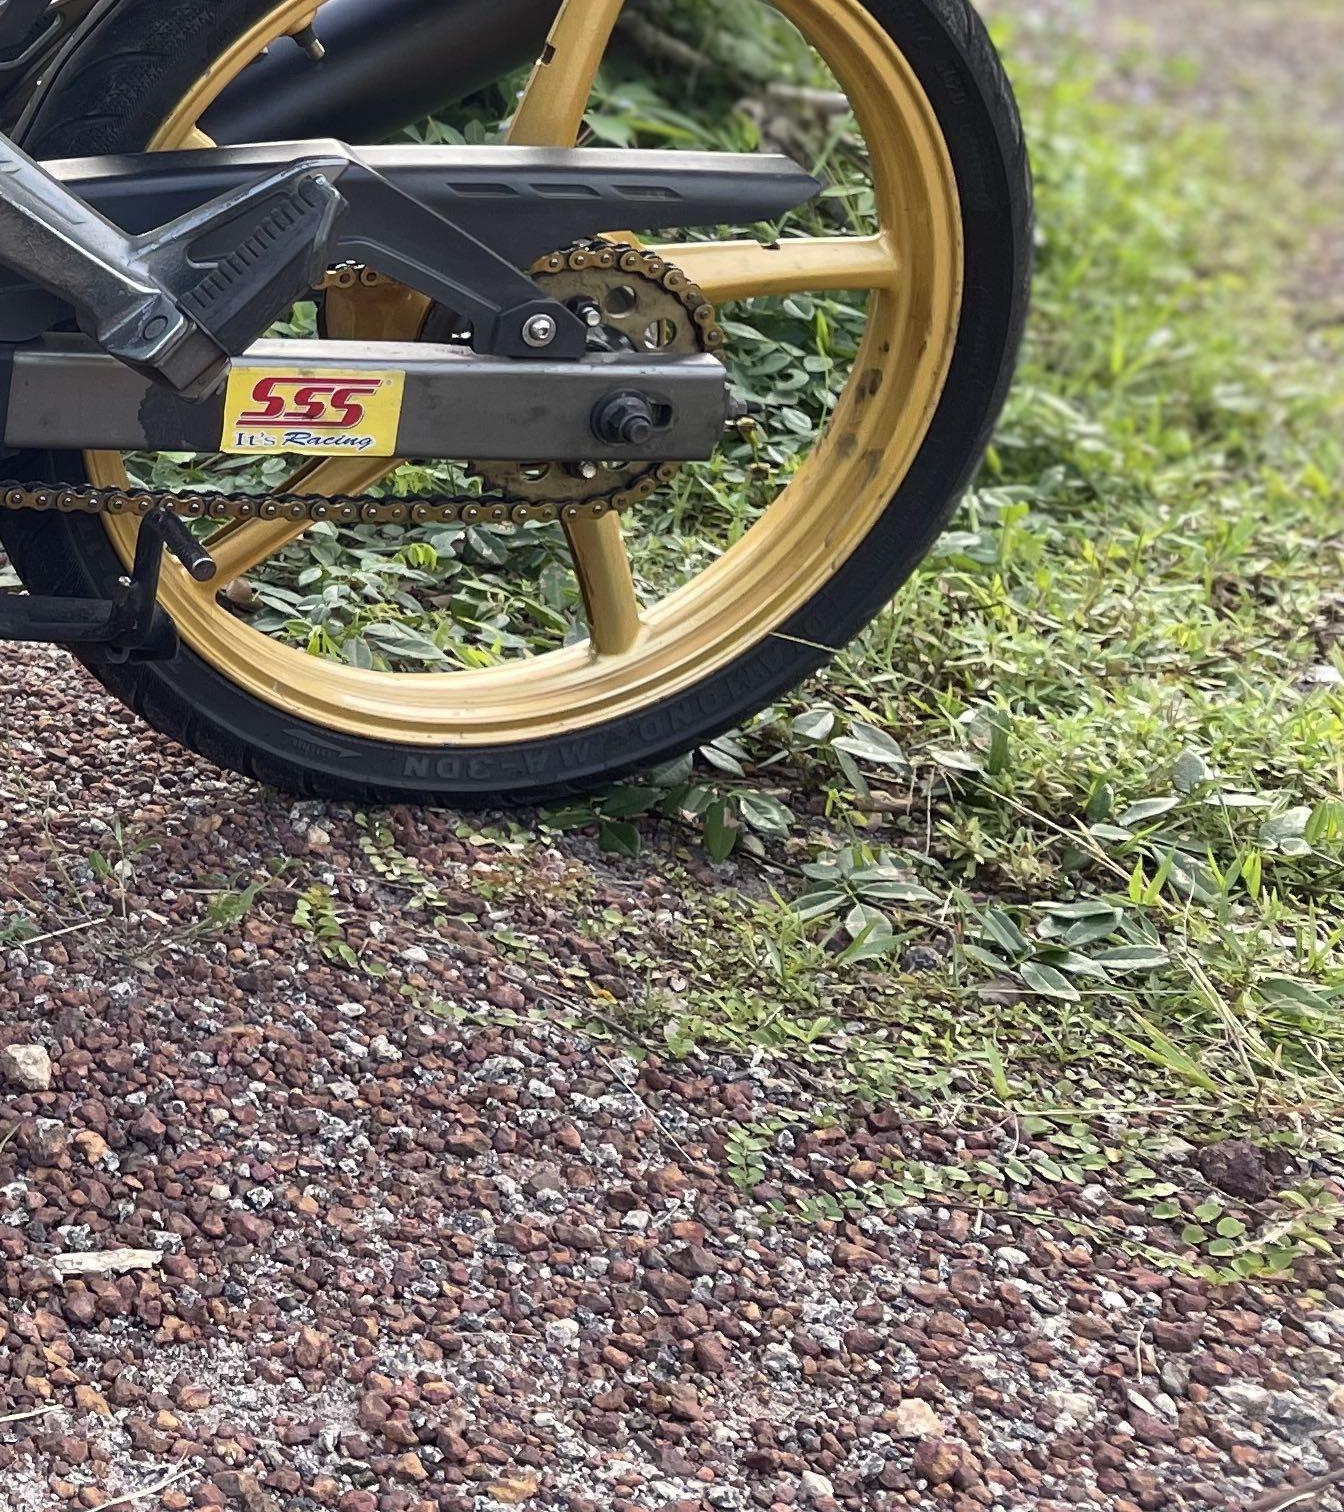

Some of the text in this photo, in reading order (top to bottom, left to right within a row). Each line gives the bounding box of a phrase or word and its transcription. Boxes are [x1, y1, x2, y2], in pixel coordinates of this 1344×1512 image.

[234, 377, 383, 429] SSS
[235, 431, 374, 451] It's Racing
